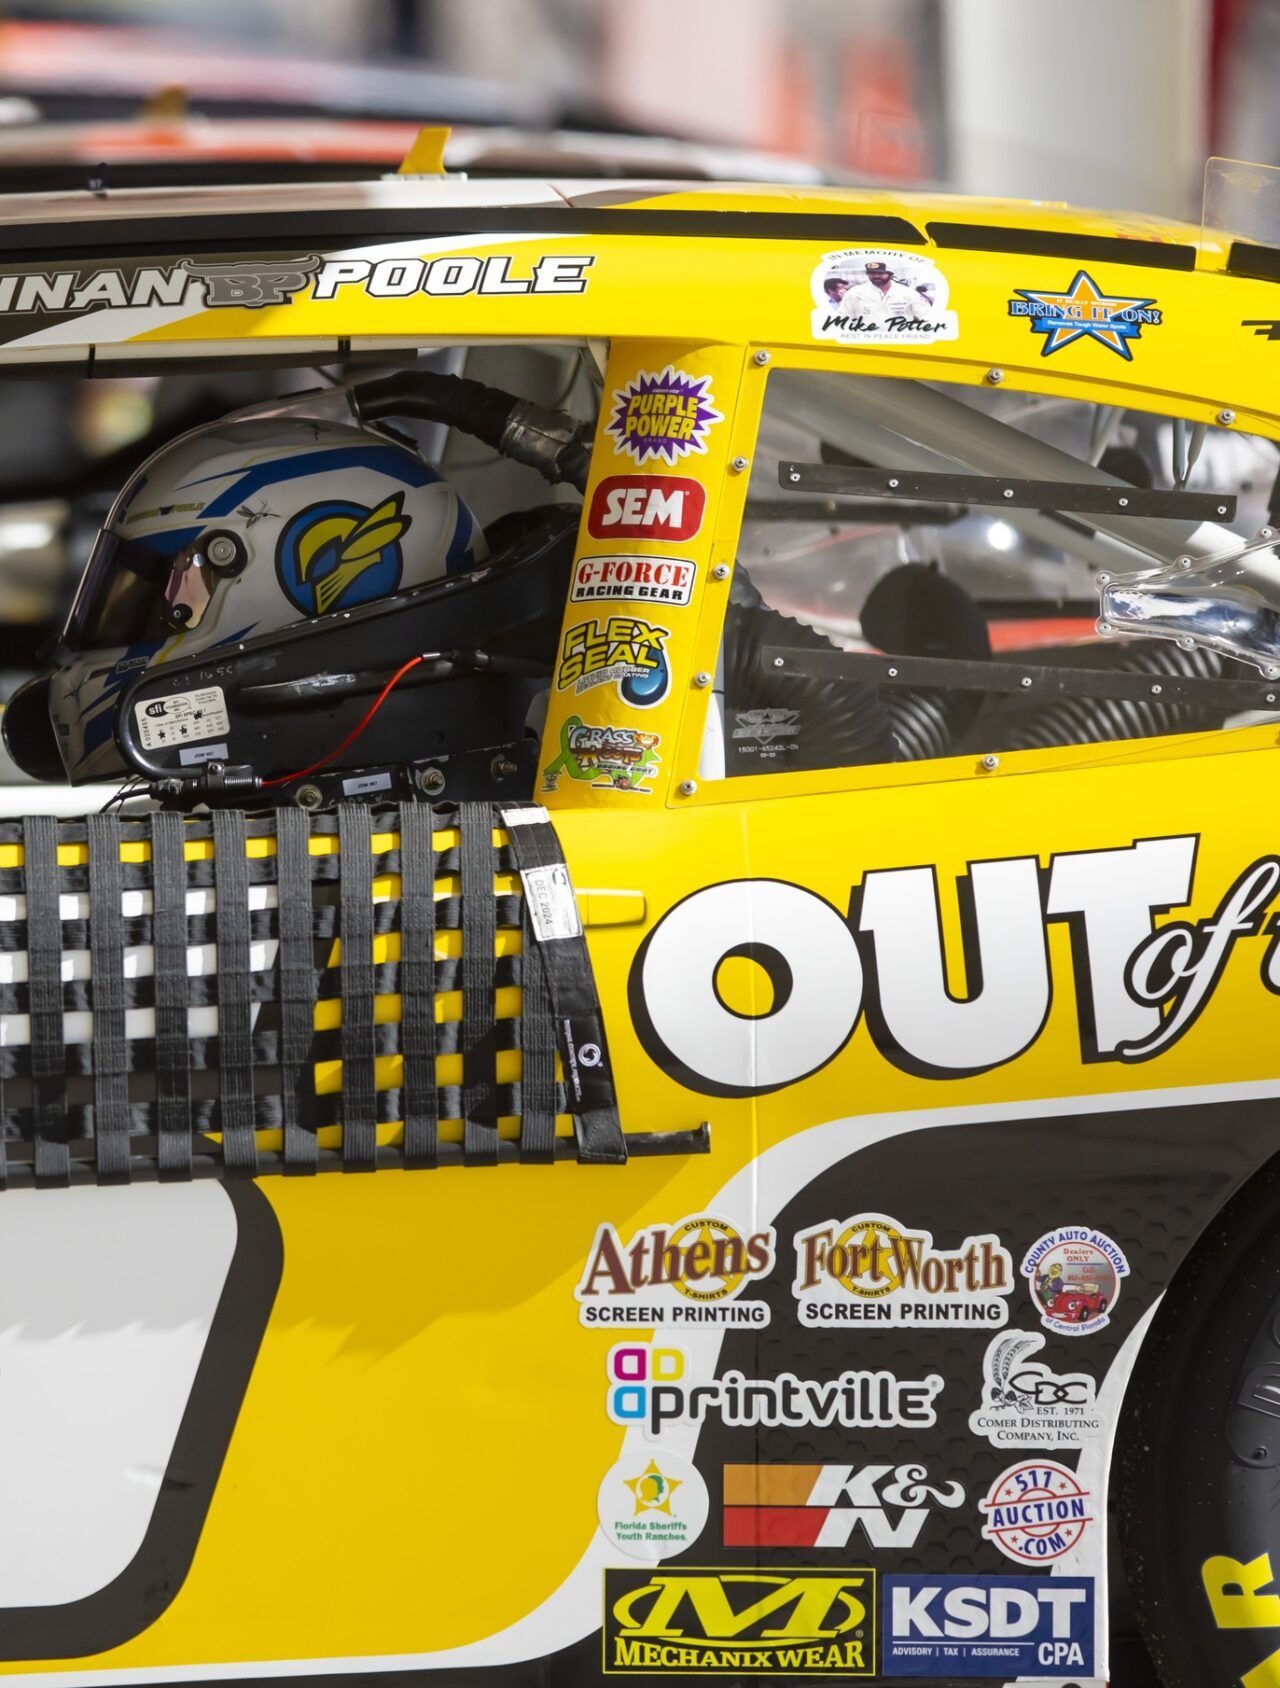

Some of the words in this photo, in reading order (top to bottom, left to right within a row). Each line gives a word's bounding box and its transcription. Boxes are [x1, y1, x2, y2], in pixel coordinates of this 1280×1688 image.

[311, 256, 596, 299] POOLE
[822, 314, 880, 332] Mike
[885, 315, 947, 332] Potter
[1010, 301, 1082, 318] BRING
[1091, 306, 1114, 319] IT
[1121, 308, 1161, 323] ON!
[627, 394, 699, 419] PURPLE
[625, 415, 696, 440] POWER
[601, 488, 684, 529] SEM
[578, 561, 689, 588] G-FORCE
[575, 585, 634, 598] RACING
[638, 587, 683, 600] GEAR
[563, 618, 668, 660] FLEX
[558, 642, 659, 690] SEAL
[149, 704, 163, 715] sfi
[569, 727, 638, 749] GRASS
[630, 834, 1200, 1096] OUT
[1127, 857, 1280, 1061] of
[684, 1220, 729, 1231] CUSTOM
[851, 1222, 892, 1232] CUSTOM
[581, 1228, 770, 1296] Athens
[800, 1228, 884, 1290] Fort
[888, 1235, 1007, 1294] Worth
[1024, 1236, 1056, 1274] COUNTY
[1058, 1230, 1089, 1243] AUTO
[1090, 1235, 1126, 1274] AUCTION
[684, 1288, 729, 1300] T-SHIRTS
[851, 1286, 892, 1297] T-SHIRTS
[586, 1307, 664, 1322] SCREEN
[673, 1307, 764, 1322] PRINTING
[806, 1304, 891, 1320] SCREEN
[900, 1304, 1001, 1320] PRINTING
[1053, 1320, 1080, 1332] Central
[1036, 1407, 1059, 1415] EST.
[1064, 1407, 1085, 1415] 1971
[977, 1417, 1017, 1428] COMER
[1021, 1417, 1100, 1428] DISTRIBUTING
[996, 1430, 1054, 1441] COMPANY,
[1056, 1431, 1080, 1440] INC.
[1014, 1469, 1052, 1492] 517
[993, 1498, 1085, 1527] AUCTION
[614, 1522, 647, 1530] Florida
[649, 1522, 687, 1530] Sheriffs
[616, 1532, 643, 1541] Youth
[645, 1532, 686, 1541] Ranches
[1018, 1532, 1067, 1556] .COM
[892, 1587, 1086, 1639] KSDT
[614, 1636, 773, 1667] MECHANIX
[776, 1641, 865, 1668] WEAR
[892, 1647, 933, 1656] ADVISORY
[943, 1647, 959, 1656] TAX
[971, 1647, 1020, 1656] ASSURANCE
[1037, 1642, 1085, 1666] CPA
